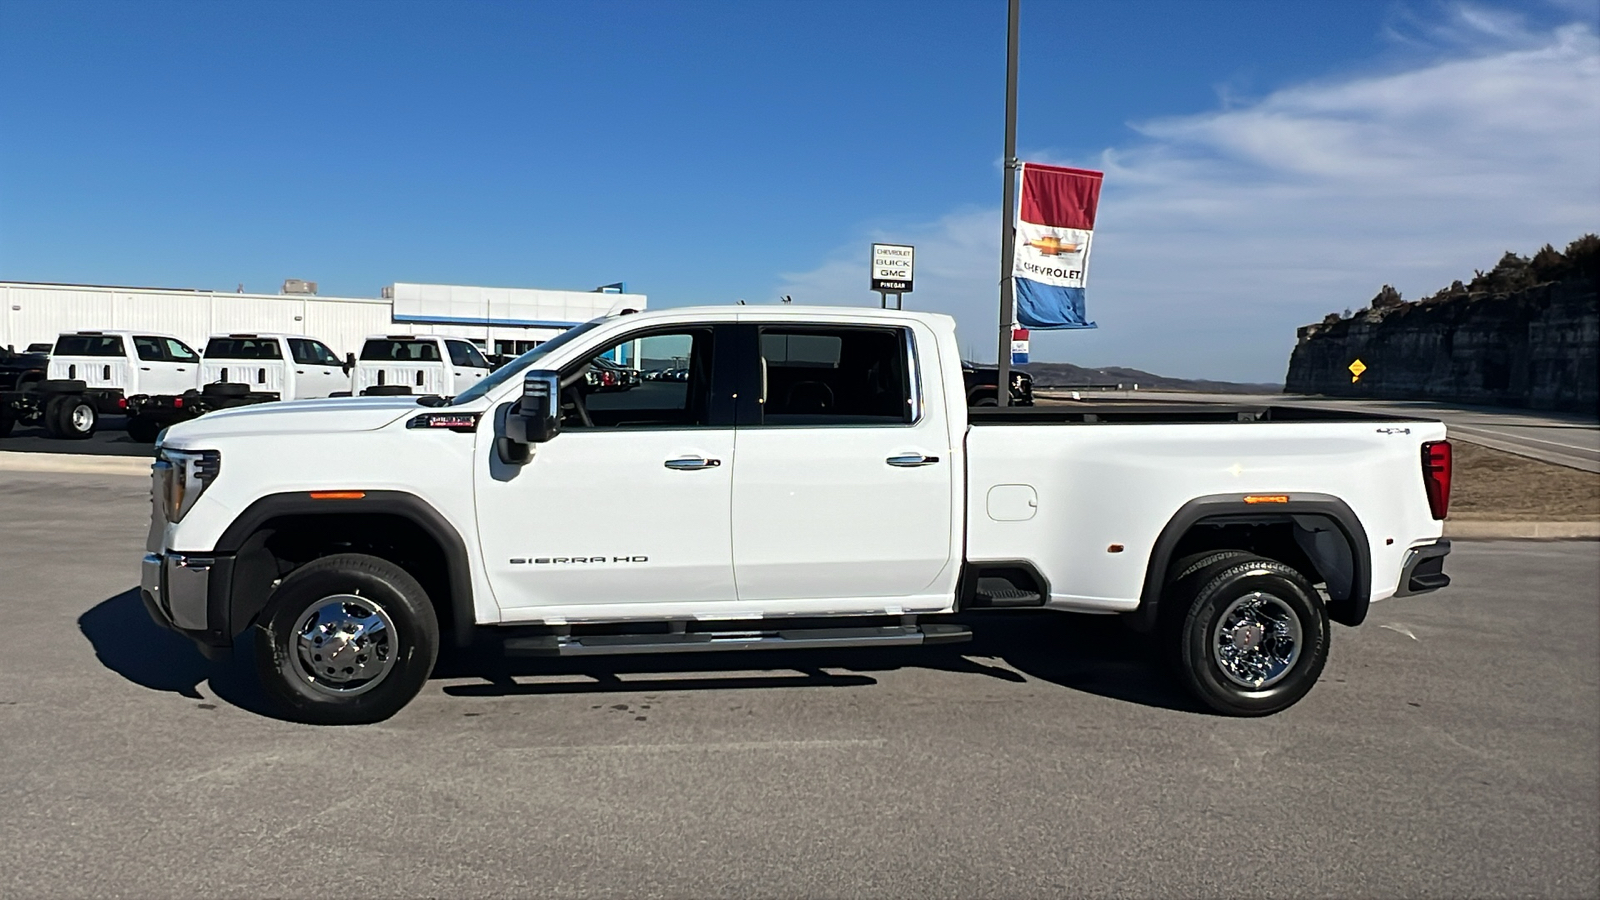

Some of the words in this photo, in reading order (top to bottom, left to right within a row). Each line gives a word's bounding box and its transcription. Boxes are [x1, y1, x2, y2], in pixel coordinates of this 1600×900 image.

[876, 259, 911, 267] BUICK
[880, 269, 906, 277] GMC
[1024, 261, 1081, 279] CHEVROLET
[509, 556, 607, 564] SIERRA
